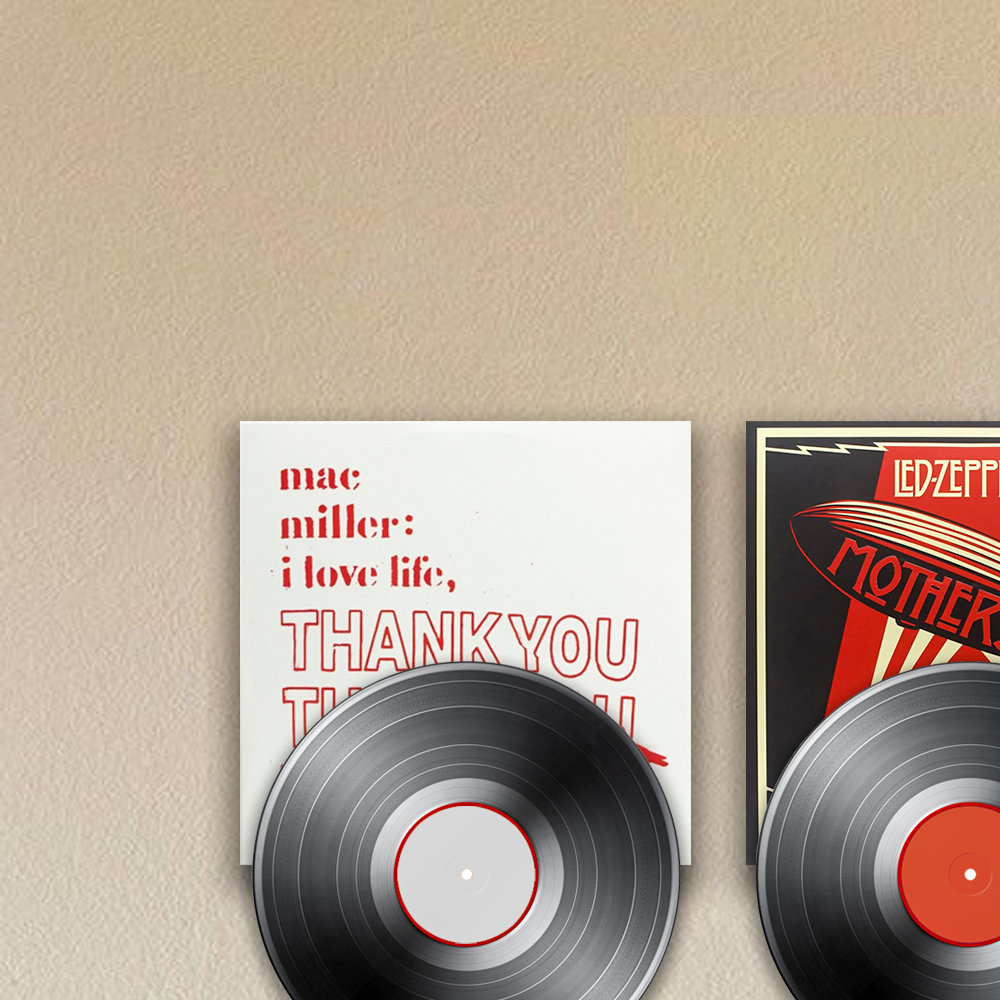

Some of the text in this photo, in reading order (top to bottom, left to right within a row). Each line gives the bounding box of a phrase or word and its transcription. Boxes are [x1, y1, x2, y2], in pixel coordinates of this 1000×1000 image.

[280, 467, 361, 490] mac
[280, 504, 414, 539] miller:
[282, 555, 456, 593] i love life,
[280, 609, 639, 682] THANK YOU
